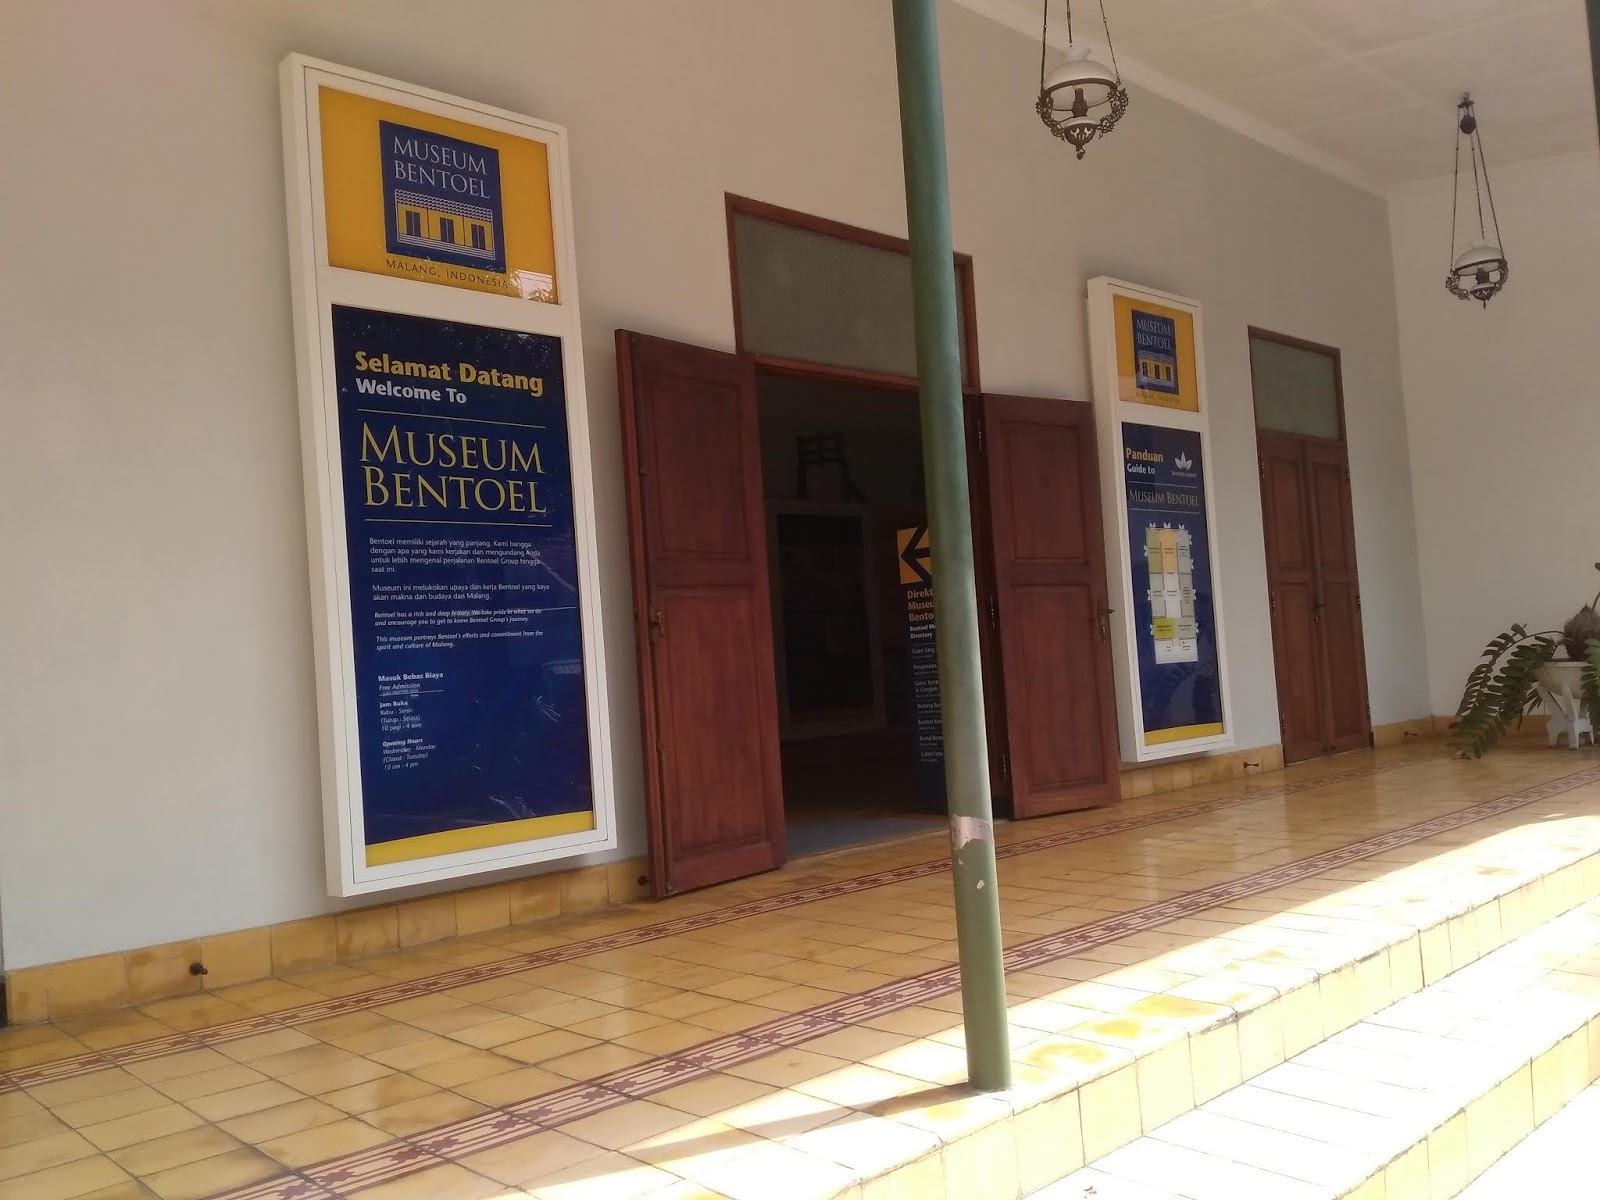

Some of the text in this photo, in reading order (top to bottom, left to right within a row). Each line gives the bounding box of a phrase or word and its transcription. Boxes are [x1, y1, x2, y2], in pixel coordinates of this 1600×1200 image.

[393, 135, 488, 176] MUSEUM
[394, 159, 490, 199] BENTOEL
[386, 259, 509, 289] MALANG, INDONESIA
[1136, 318, 1172, 336] MUSEUM
[1136, 332, 1172, 350] BENTOEL
[355, 350, 544, 398] Selamat Datang
[355, 377, 467, 404] Welcome To
[359, 421, 546, 474] MUSEUM
[1125, 447, 1164, 463] Panduan
[1126, 463, 1156, 475] Guide to
[361, 465, 547, 514] BENTOEL
[1129, 489, 1200, 507] MUSEUM BENTOEL
[370, 537, 395, 545] Bentoel
[425, 538, 448, 547] sejarah
[510, 540, 532, 549] bangga
[370, 547, 396, 556] dengan
[485, 549, 524, 557] mengundang
[410, 556, 442, 565] mengenal
[443, 557, 475, 565] perjalanan
[500, 558, 519, 566] Group
[520, 558, 540, 566] hingga
[428, 592, 452, 601] budaya
[906, 588, 934, 600] Direkt
[908, 601, 934, 610] Museu
[909, 612, 934, 622] Bento
[376, 643, 391, 652] spirit
